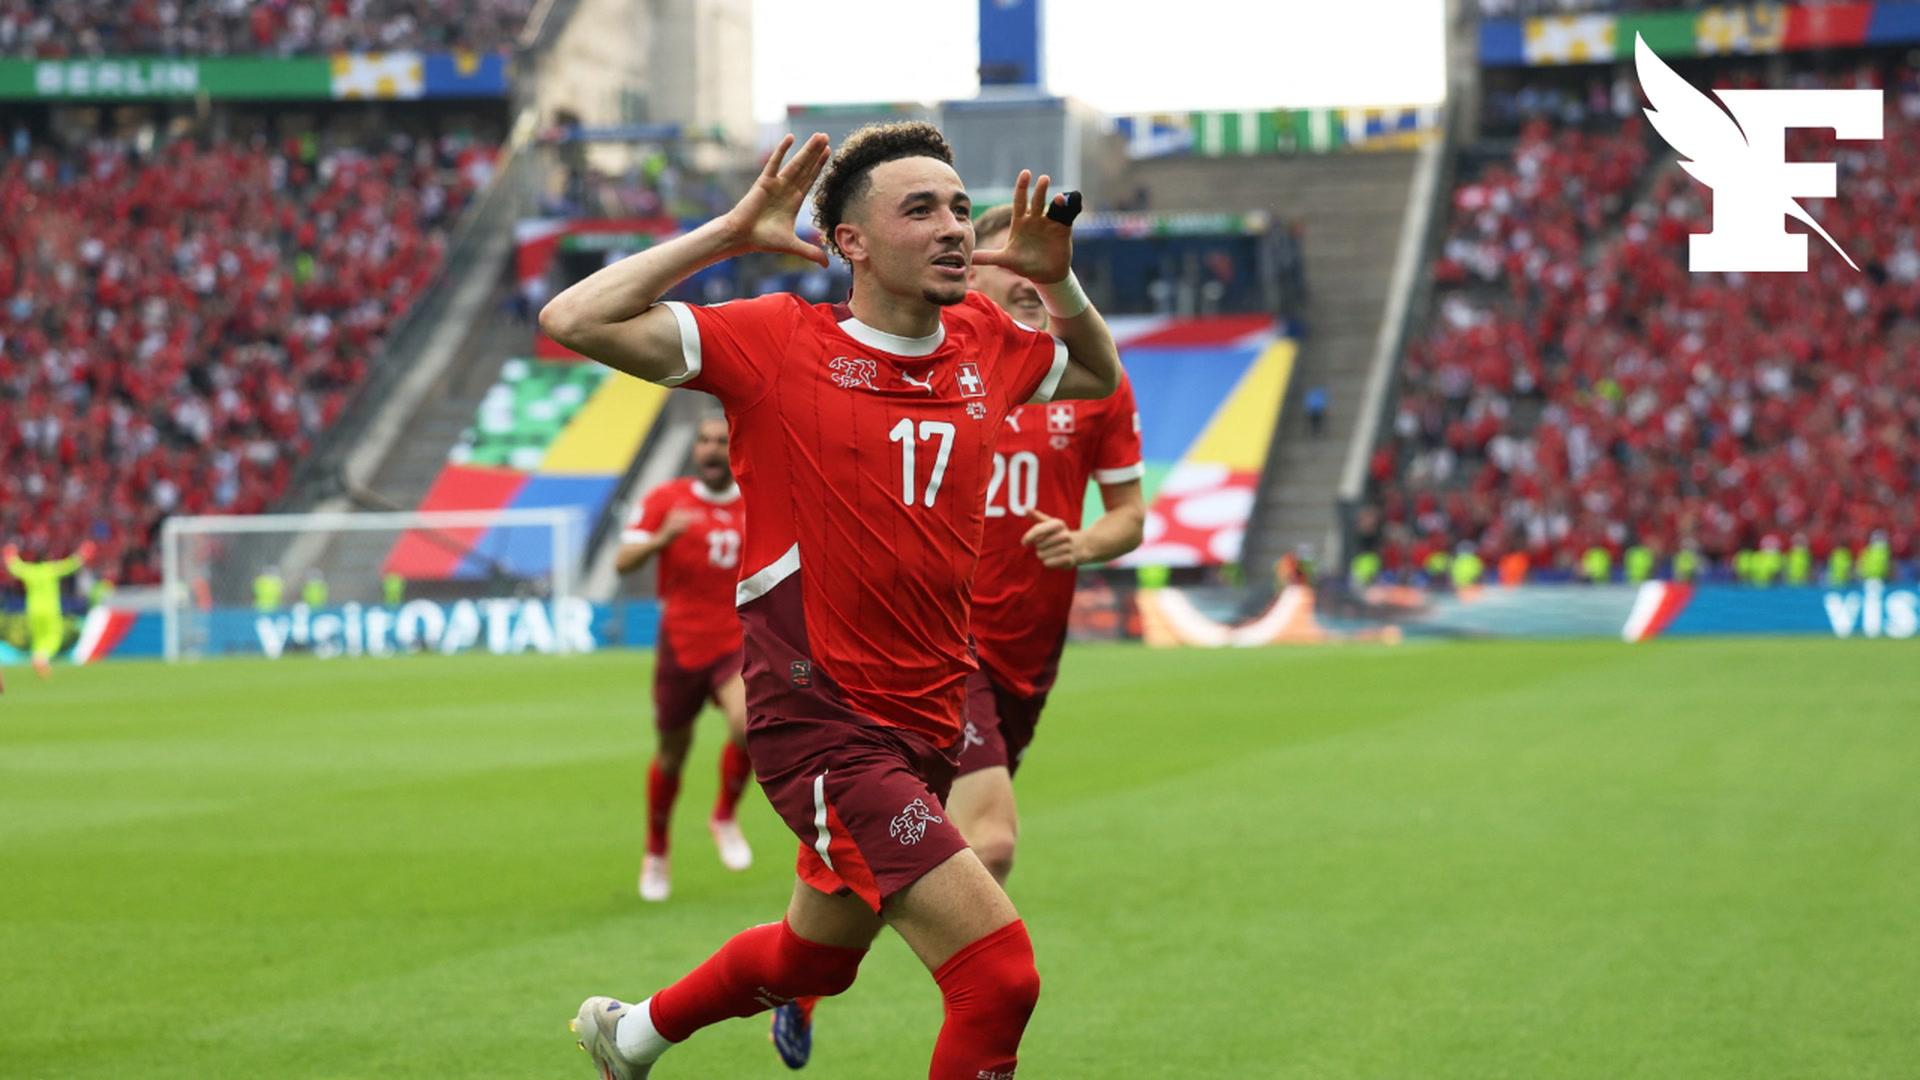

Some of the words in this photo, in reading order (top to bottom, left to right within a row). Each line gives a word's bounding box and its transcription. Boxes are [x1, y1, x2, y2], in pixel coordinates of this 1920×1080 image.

[36, 62, 198, 95] BERLIN
[889, 418, 956, 507] 17
[985, 451, 1038, 516] 20
